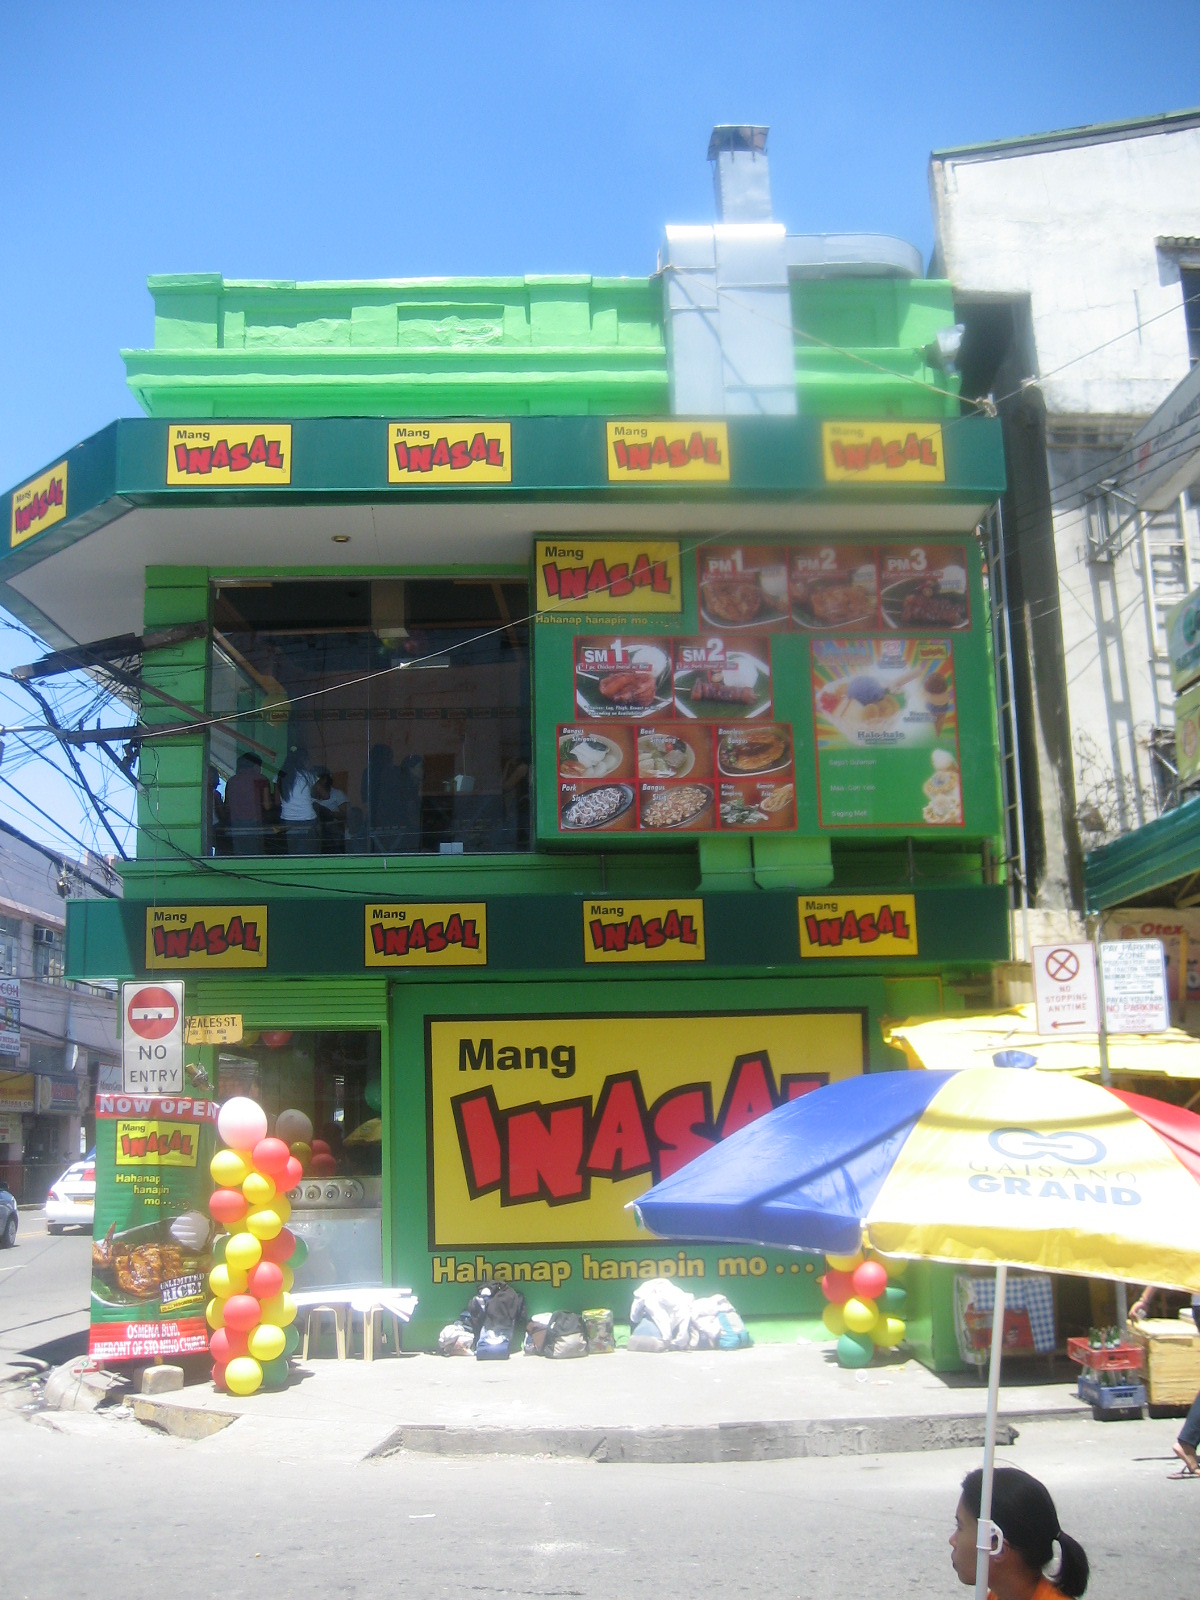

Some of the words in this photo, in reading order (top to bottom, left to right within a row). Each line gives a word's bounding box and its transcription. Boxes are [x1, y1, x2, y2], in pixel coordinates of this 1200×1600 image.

[176, 429, 211, 442] Mang
[395, 428, 430, 440] Mang
[613, 426, 648, 438] Mang
[173, 434, 285, 475] INASAL
[394, 432, 505, 473] INASAL
[612, 431, 722, 471] INASAL
[829, 432, 938, 471] INASAL
[14, 477, 65, 535] INASAL
[545, 546, 584, 560] Mang
[542, 553, 671, 600] INASAL
[535, 615, 582, 625] Hahanap
[585, 615, 627, 625] hanapin
[642, 784, 665, 792] Bangus
[590, 905, 624, 917] Mang
[804, 901, 839, 913] Mang
[153, 911, 187, 923] Mang
[372, 909, 406, 921] Mang
[589, 909, 698, 952] INASAL
[804, 905, 910, 947] INASAL
[152, 915, 262, 959] INASAL
[370, 912, 480, 956] INASAL
[1122, 943, 1161, 951] PARKING
[1045, 995, 1088, 1004] STOPPING
[1048, 1004, 1088, 1013] ANYTIME
[1106, 1004, 1120, 1013] NO
[1123, 1003, 1164, 1012] PARKING
[224, 1016, 238, 1027] ST.
[139, 1045, 167, 1060] NO
[458, 1038, 576, 1078] Mang
[130, 1069, 178, 1083] ENTRY
[100, 1097, 151, 1113] NOW
[160, 1100, 218, 1120] OPEN
[122, 1123, 146, 1132] Mang
[450, 1049, 830, 1207] INASA
[120, 1130, 193, 1158] INASAL
[115, 1174, 160, 1184] Hahanap
[968, 1174, 1142, 1206] GRAND
[431, 1254, 571, 1286] Hahanap
[582, 1252, 705, 1281] hanapin
[160, 1272, 205, 1290] UNLIMITED
[163, 1284, 203, 1303] RICE!
[161, 1322, 180, 1337] BLVD.
[132, 1340, 142, 1355] OF
